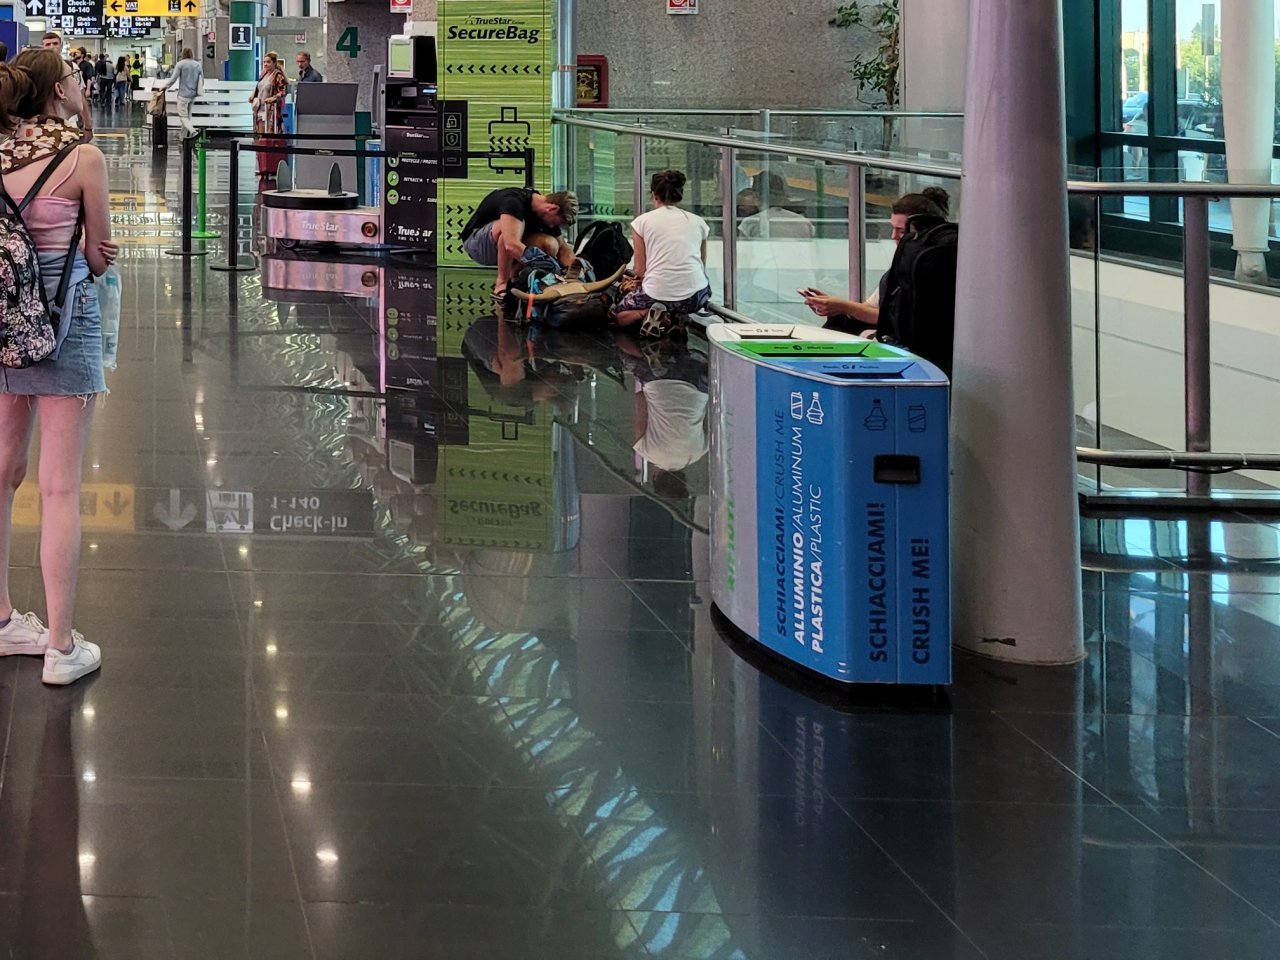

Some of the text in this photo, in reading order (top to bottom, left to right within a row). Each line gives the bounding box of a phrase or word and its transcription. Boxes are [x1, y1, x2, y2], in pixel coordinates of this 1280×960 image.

[336, 26, 362, 58] 4
[448, 25, 540, 44] SecureBag
[206, 45, 215, 59] 3
[301, 220, 340, 231] TrueStar
[398, 226, 433, 237] Truear
[791, 426, 804, 646] ALLUMINIO/ALUMINUM
[809, 486, 824, 654] PLASTICA/PLASTIC
[868, 502, 887, 662] SCHIACCIAMI!
[912, 538, 930, 664] CRUSH ME!
